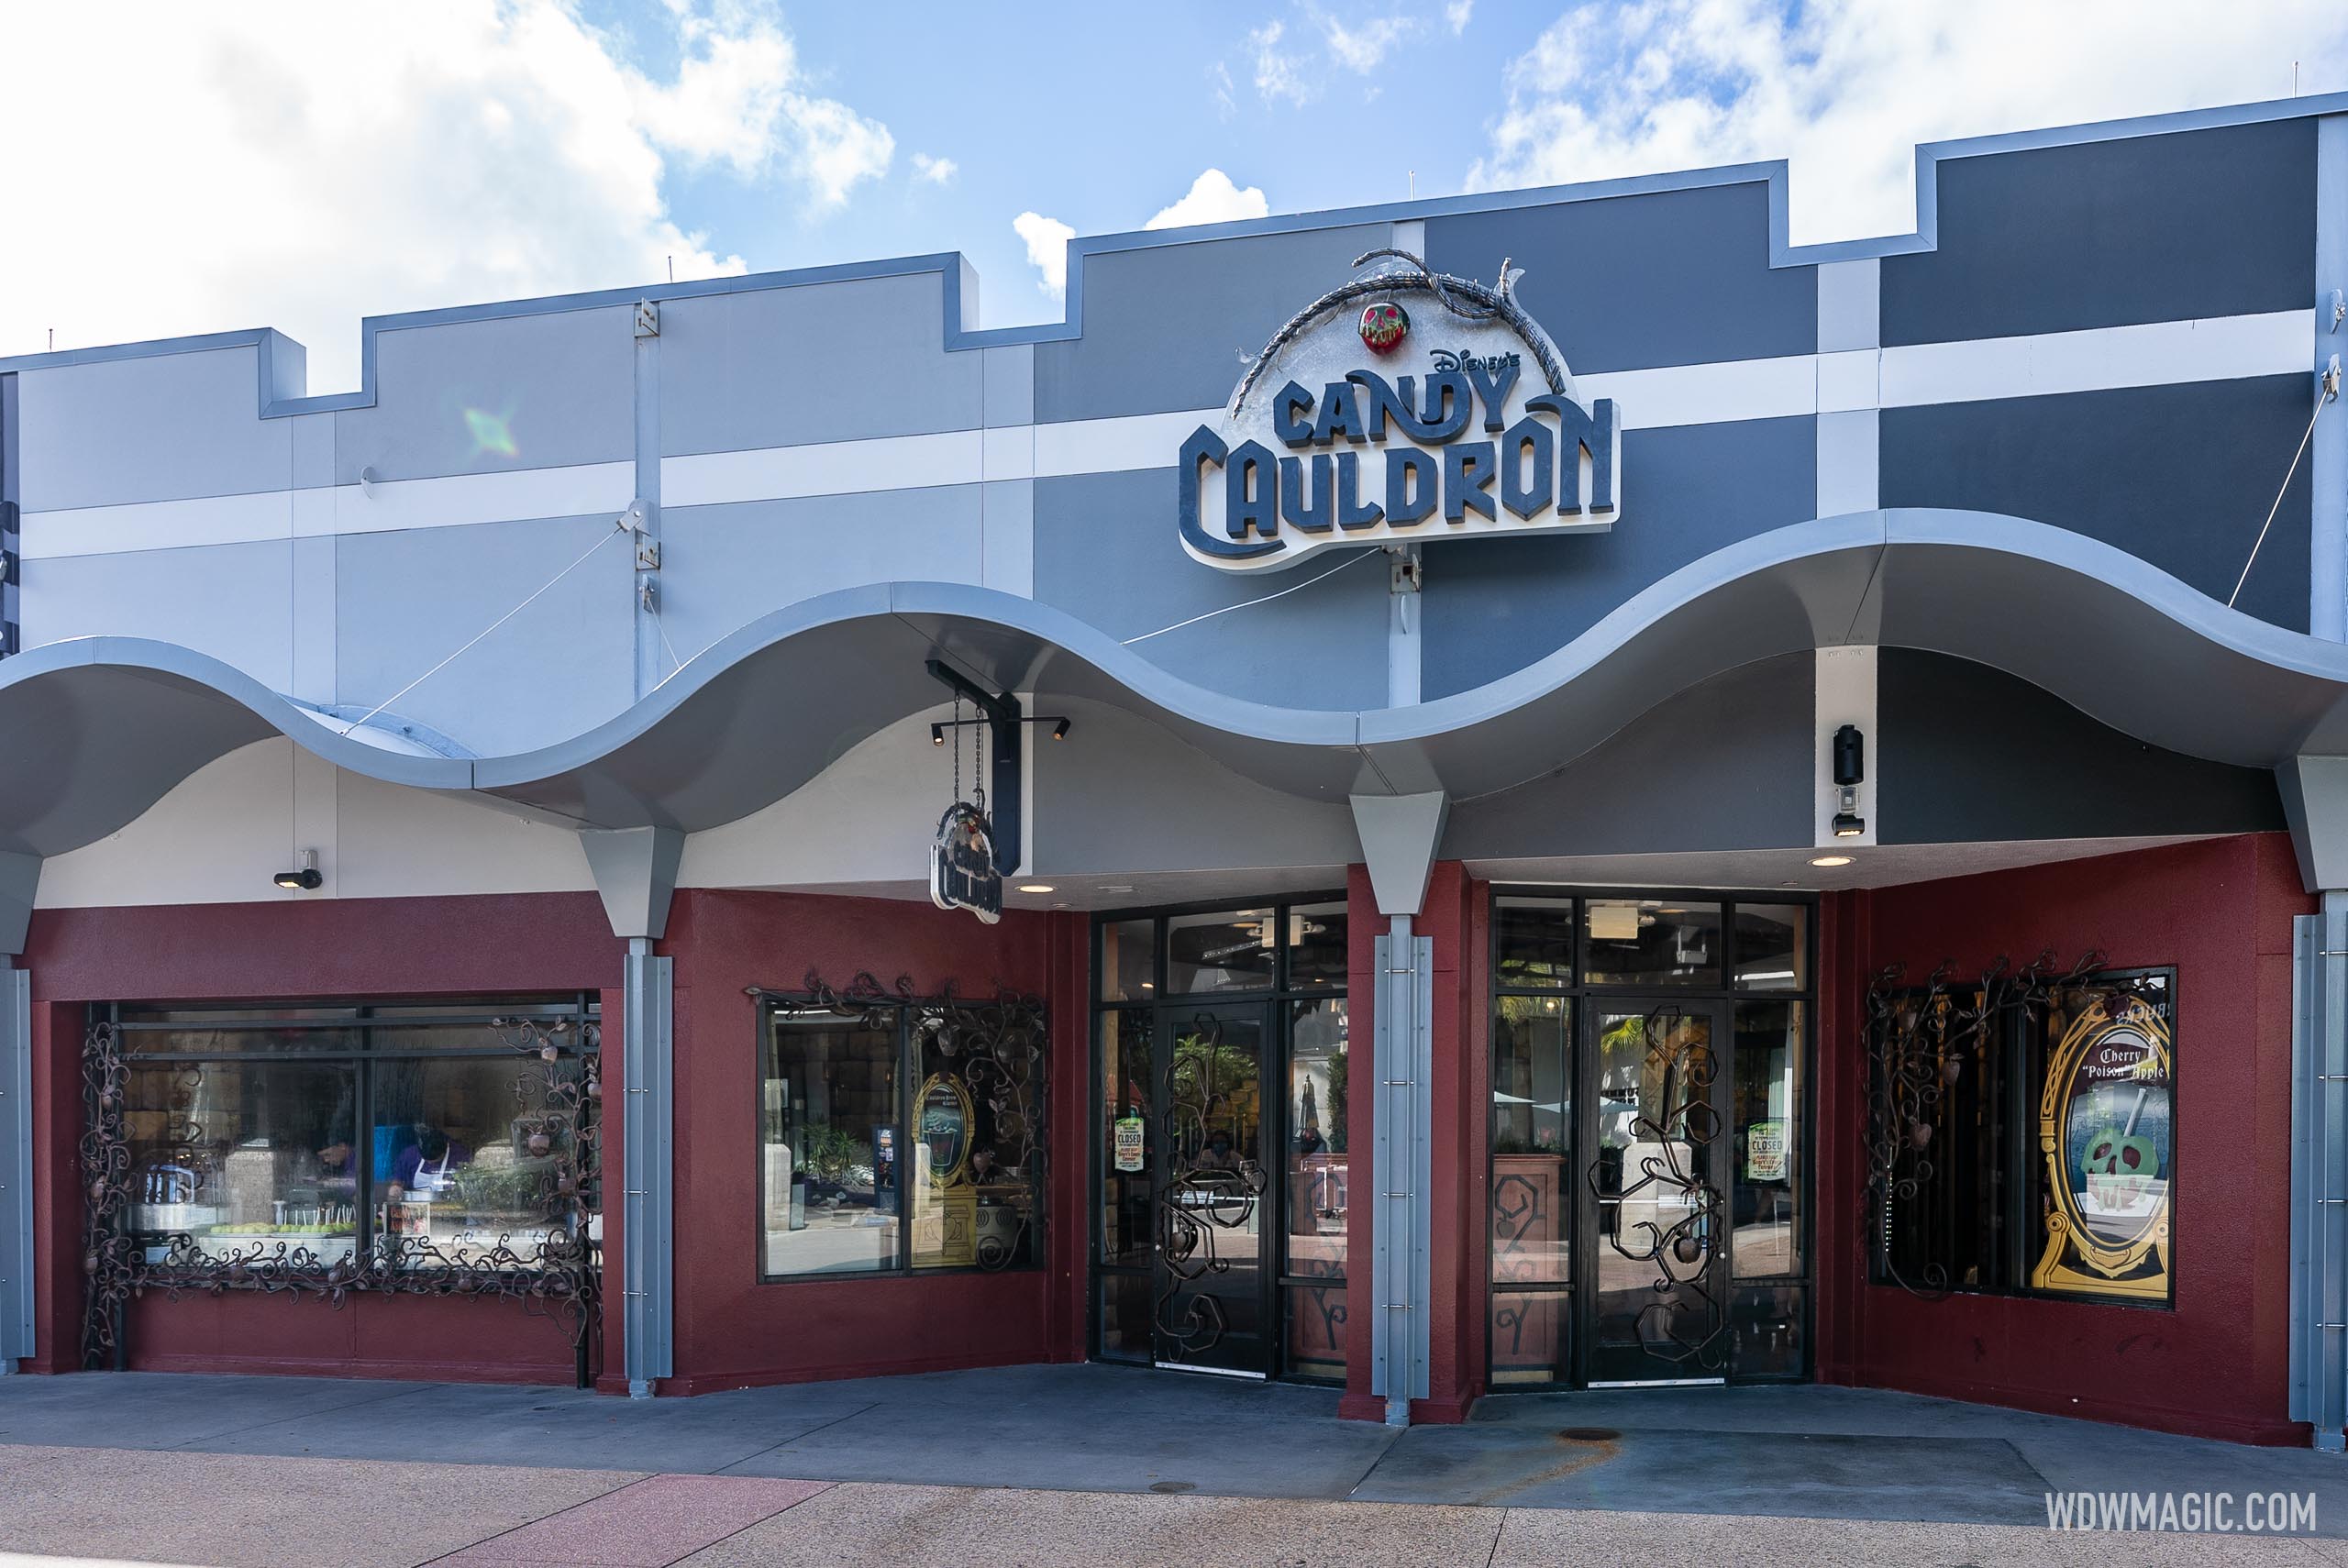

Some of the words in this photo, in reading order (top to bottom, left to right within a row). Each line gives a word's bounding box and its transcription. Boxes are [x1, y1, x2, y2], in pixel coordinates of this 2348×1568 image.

[1273, 367, 1521, 450] CANDY
[1179, 393, 1614, 560] CAULDRON
[2100, 1048, 2141, 1064] Cherry
[2132, 1067, 2164, 1080] Apple
[1117, 1134, 1141, 1143] CLOSED
[1752, 1141, 1782, 1150] CLOSED
